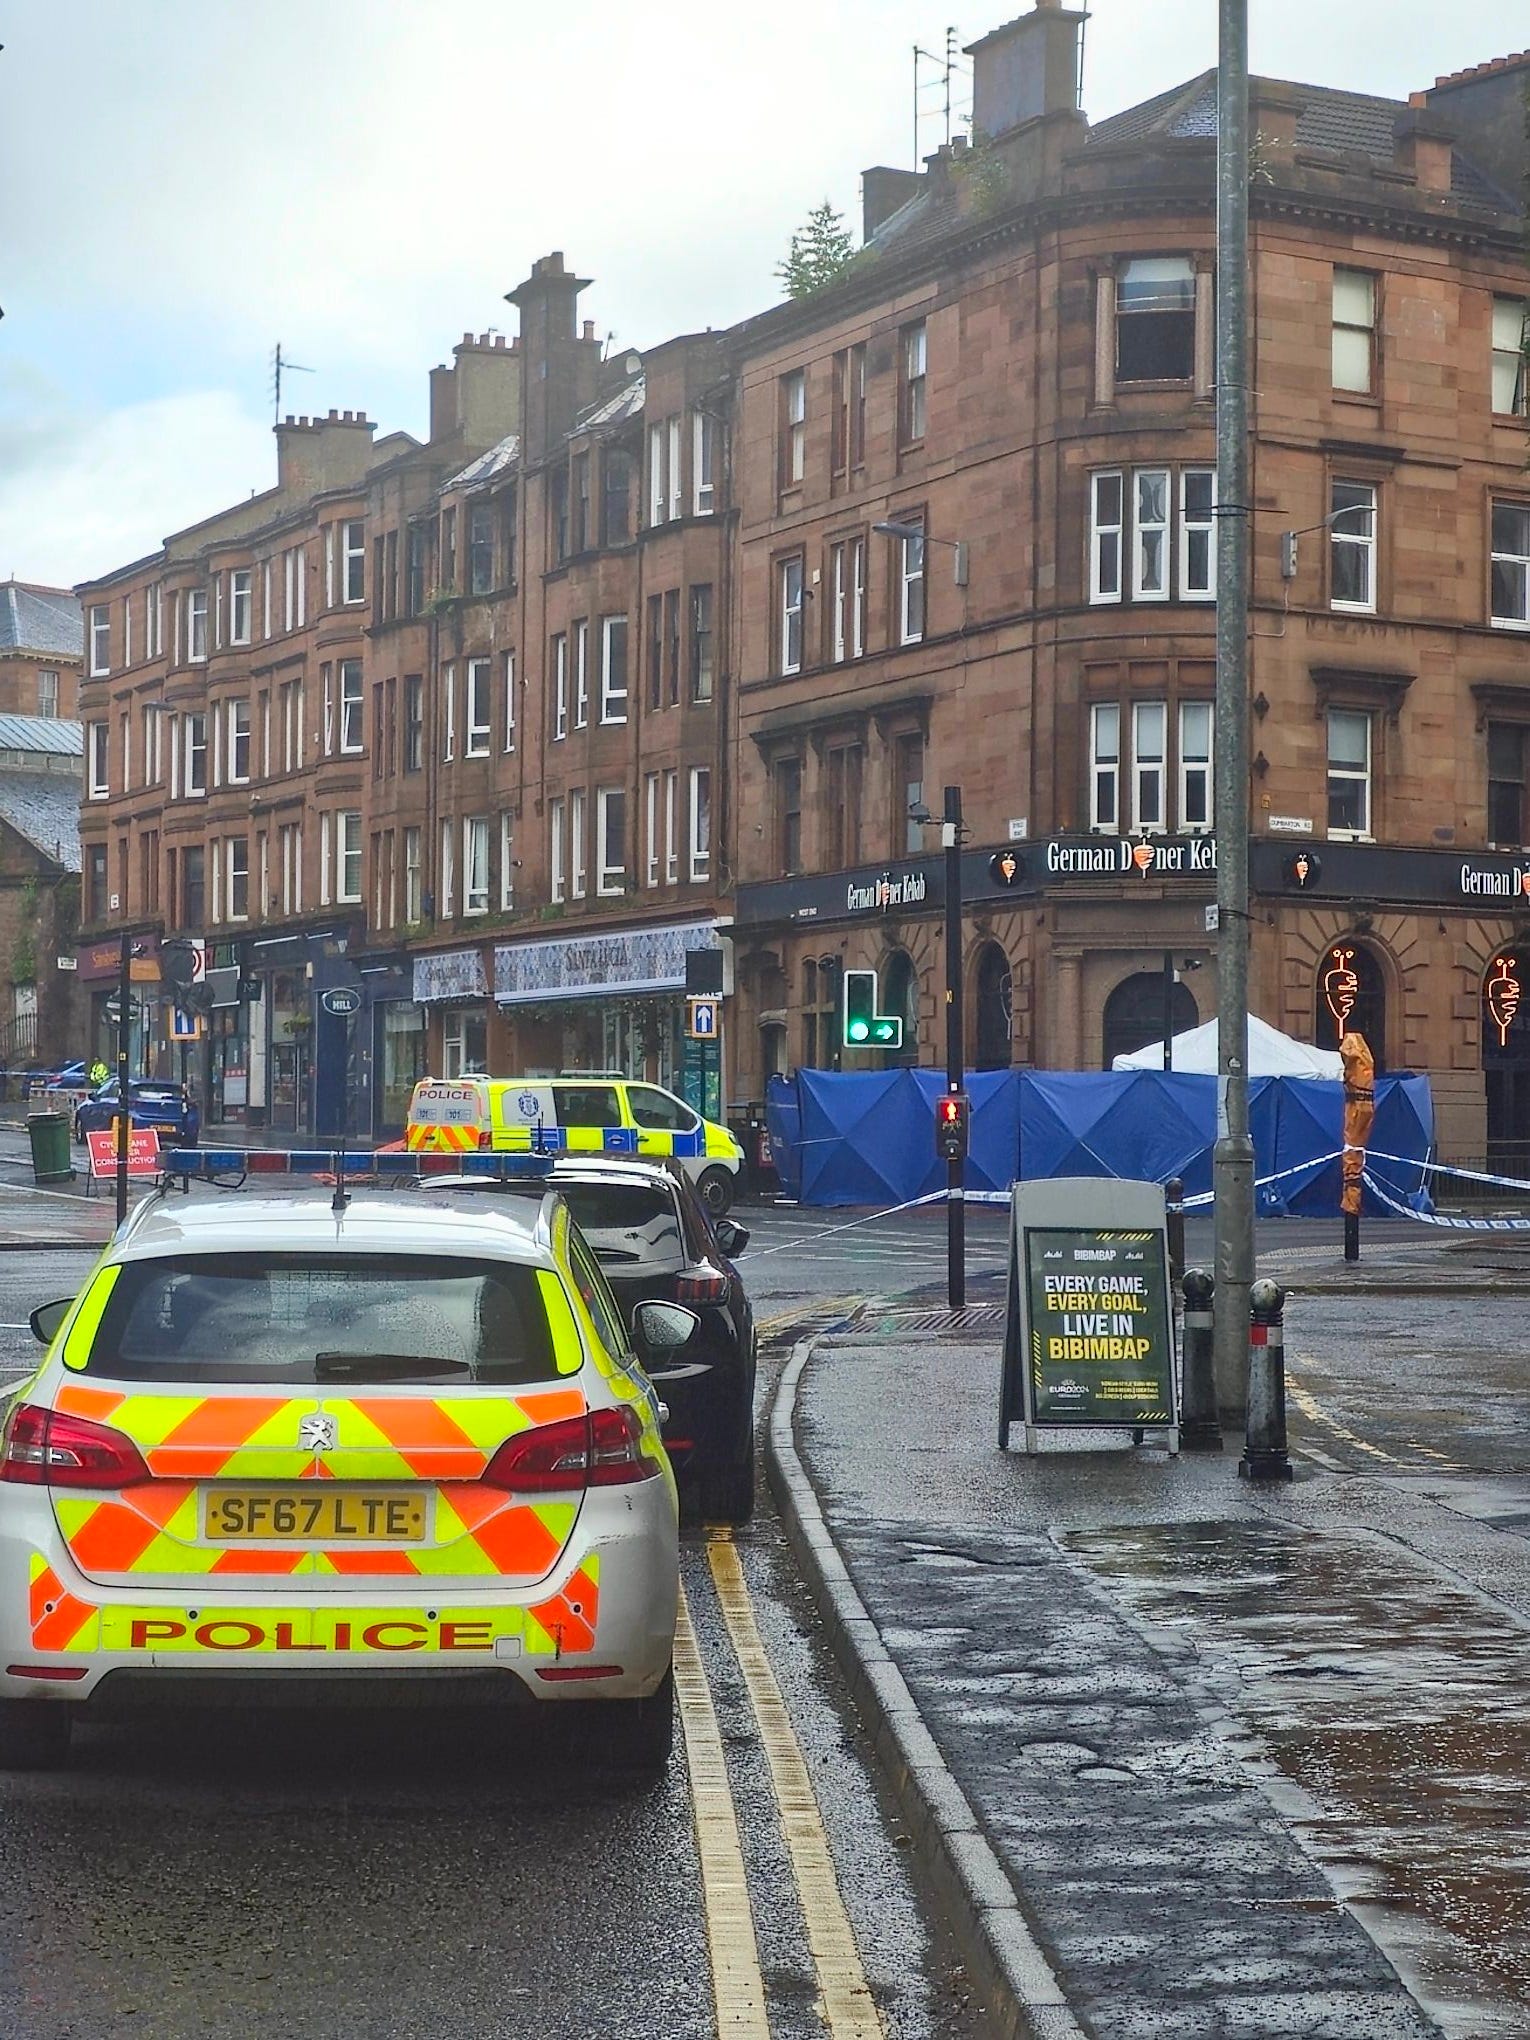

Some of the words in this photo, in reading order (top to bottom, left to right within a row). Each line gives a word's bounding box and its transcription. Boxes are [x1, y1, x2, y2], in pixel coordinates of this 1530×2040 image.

[1047, 841, 1115, 872] German
[847, 883, 875, 910] German
[902, 872, 926, 903] Kebab
[1461, 864, 1510, 896] German
[332, 1000, 352, 1010] HILL
[419, 1090, 473, 1100] POLICE
[1074, 1249, 1117, 1261] BIBIMBAP
[1044, 1275, 1095, 1293] EVERY
[1098, 1276, 1149, 1296] GAME,
[1047, 1293, 1098, 1311] EVERY
[1101, 1294, 1148, 1314] GOAL,
[1063, 1314, 1109, 1336] LIVE
[1112, 1314, 1134, 1336] IN
[1049, 1337, 1150, 1360] BIBIMBAP
[221, 1498, 324, 1534] SF67
[334, 1499, 410, 1534] LTE
[130, 1619, 494, 1651] POLICE
